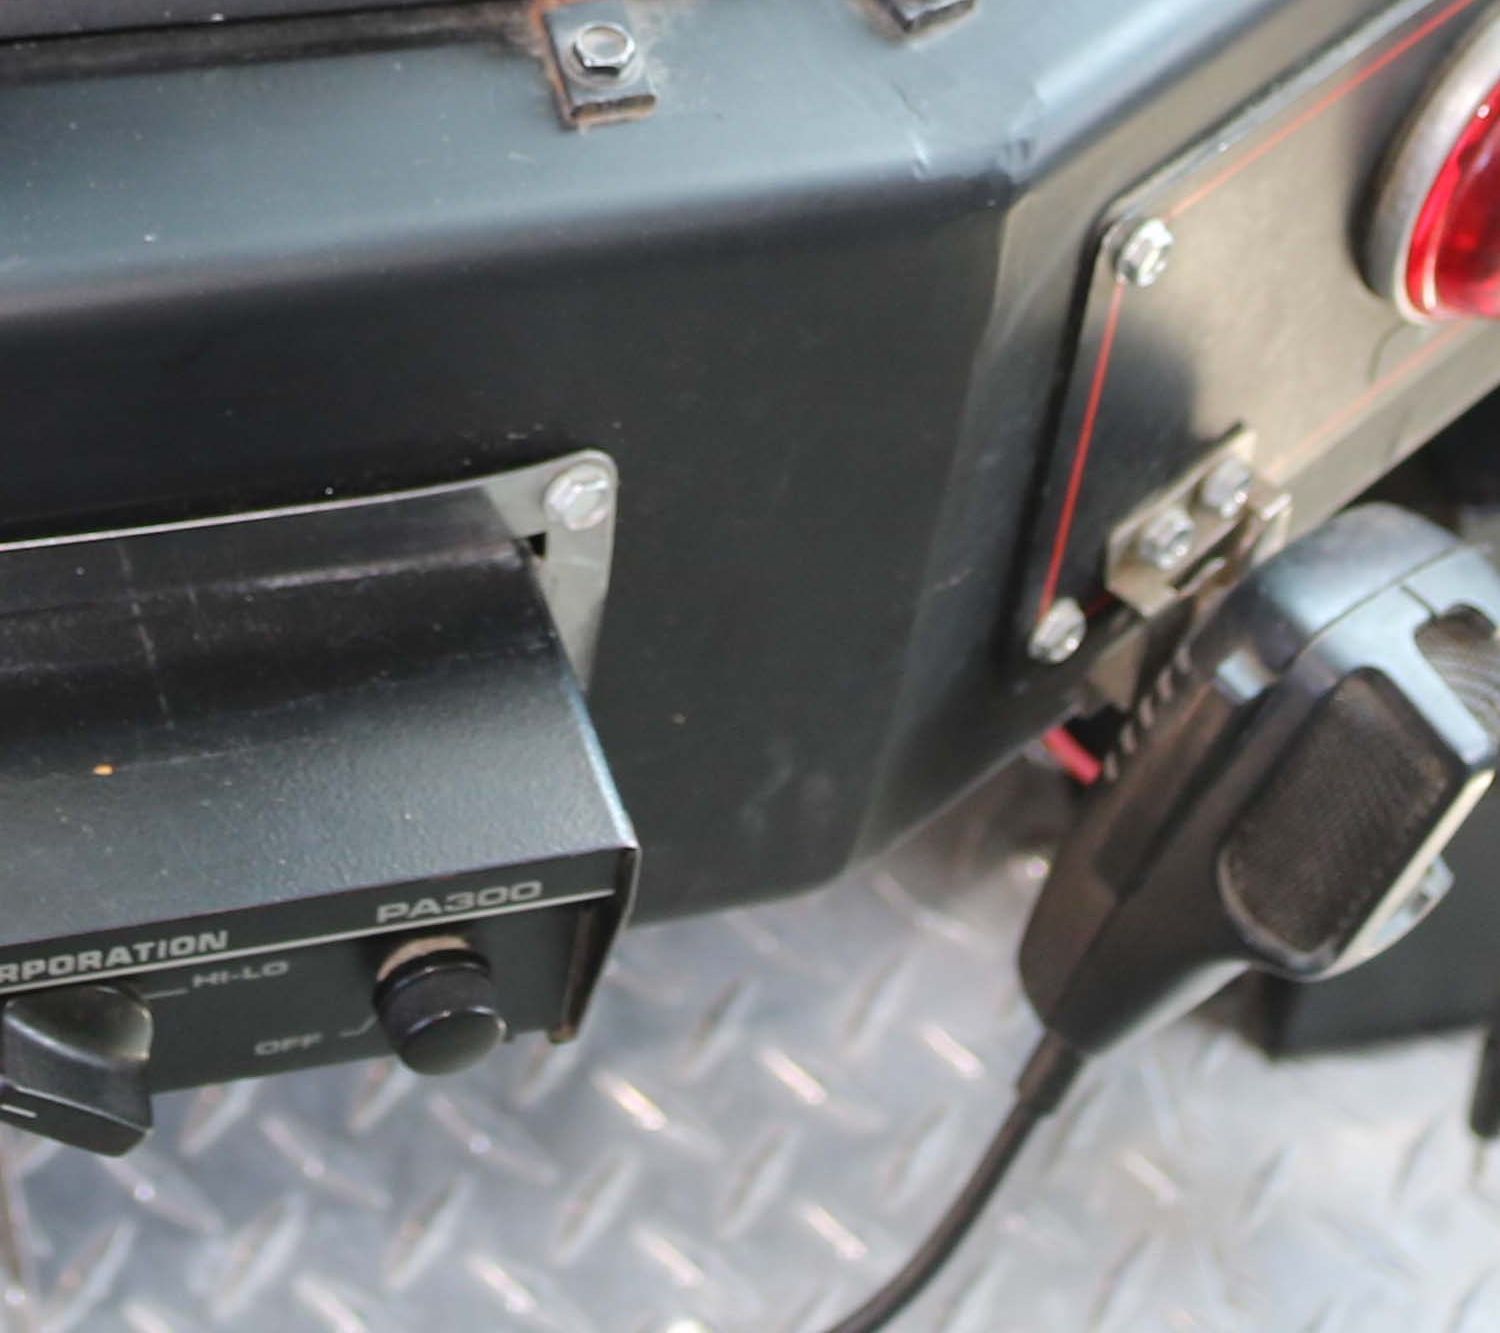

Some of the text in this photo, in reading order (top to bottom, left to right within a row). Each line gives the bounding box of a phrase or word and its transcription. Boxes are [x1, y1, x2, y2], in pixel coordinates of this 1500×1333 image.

[375, 879, 545, 924] PA300
[192, 959, 290, 989] HI-LO
[253, 1031, 324, 1057] OFF
